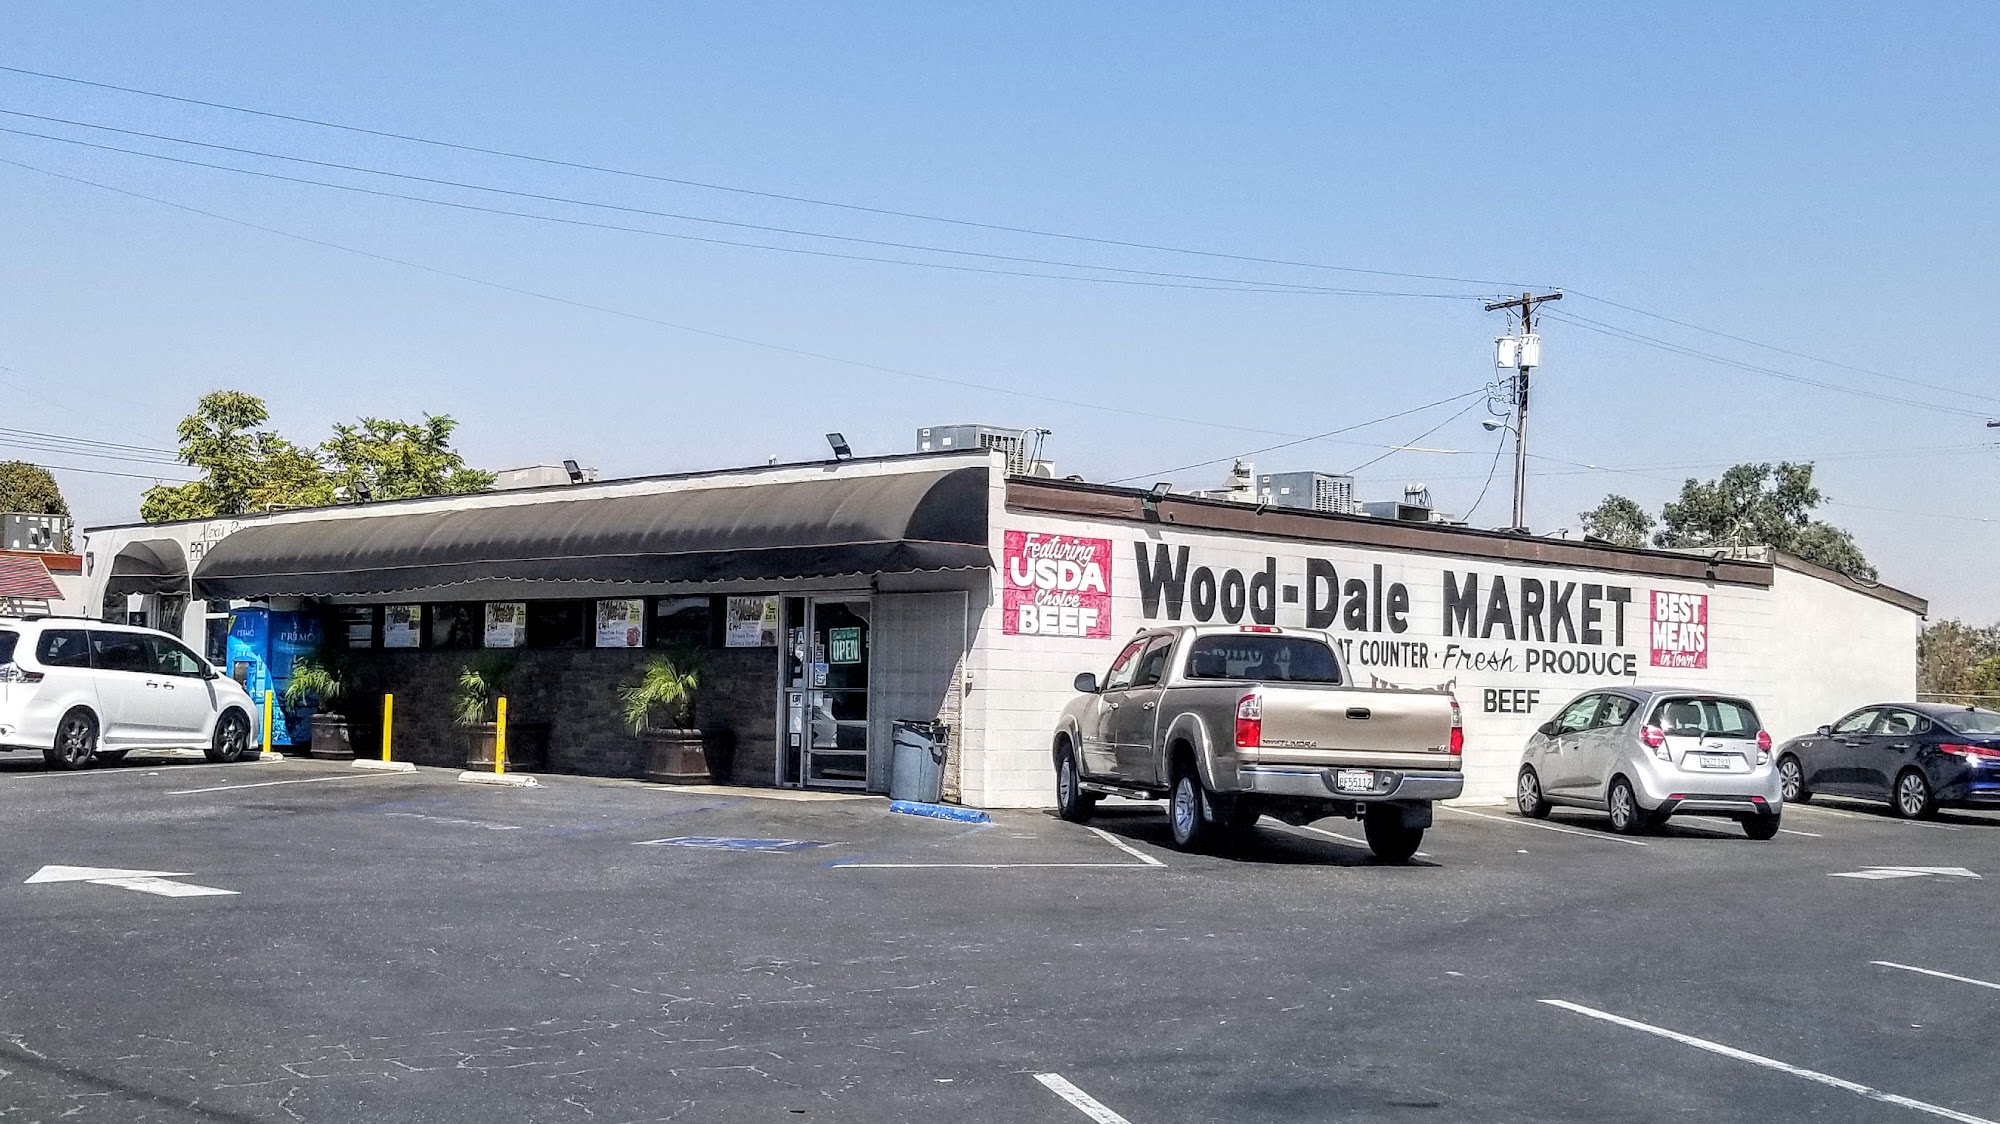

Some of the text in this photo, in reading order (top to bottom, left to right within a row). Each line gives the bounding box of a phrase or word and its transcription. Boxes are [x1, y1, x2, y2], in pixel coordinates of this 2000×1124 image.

[1023, 533, 1096, 567] Featuring
[1010, 556, 1106, 593] USDA
[1035, 588, 1080, 607] Choice
[1133, 540, 1632, 647] Wood-Dale MARKET
[1656, 592, 1702, 624] BEST
[1019, 604, 1098, 636] BEEF
[833, 639, 858, 660] OPEN
[1652, 620, 1705, 653] MEATS
[1360, 640, 1428, 668] COUNTER
[1443, 644, 1518, 672] Fresh
[1526, 649, 1636, 676] PRODUCE
[1484, 689, 1540, 713] BEEF
